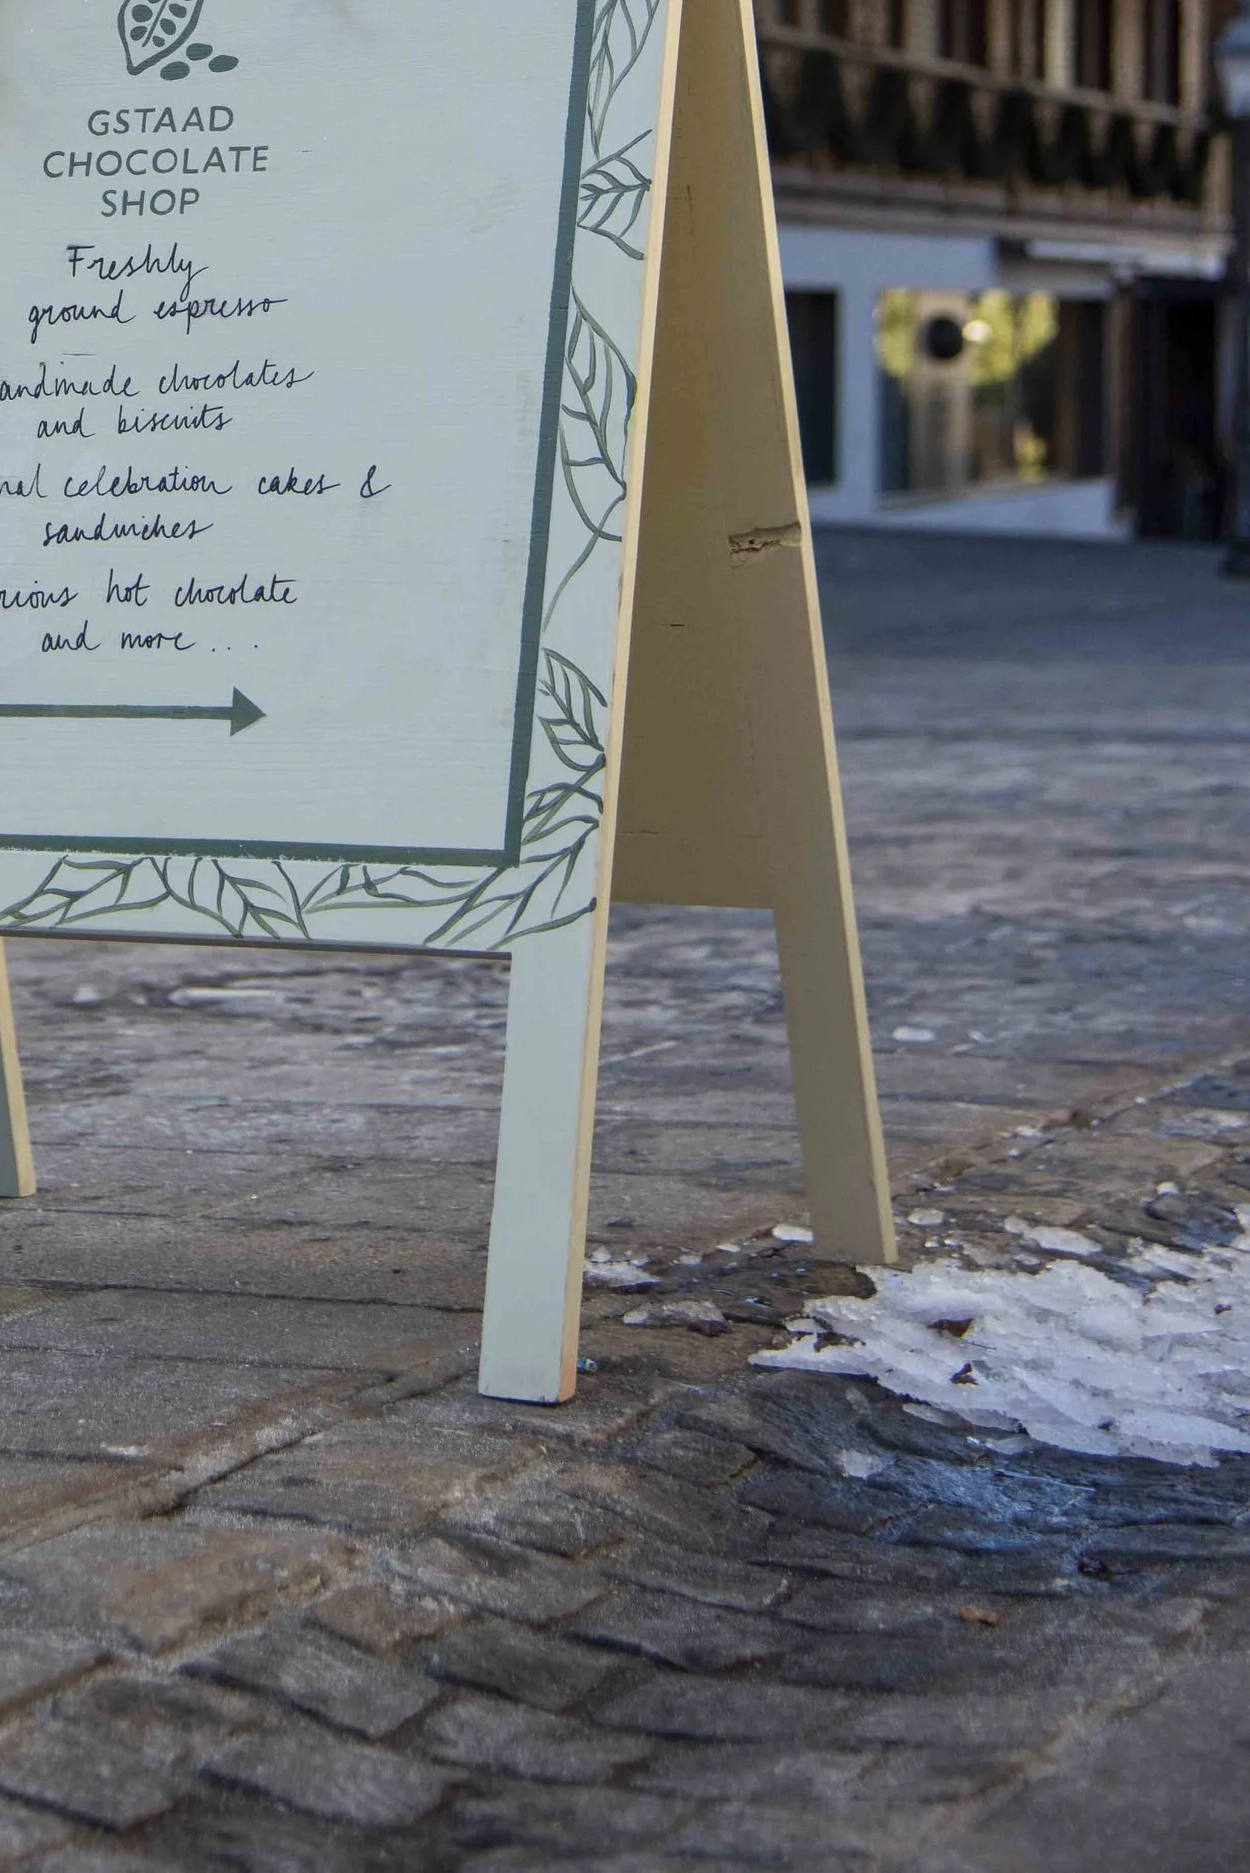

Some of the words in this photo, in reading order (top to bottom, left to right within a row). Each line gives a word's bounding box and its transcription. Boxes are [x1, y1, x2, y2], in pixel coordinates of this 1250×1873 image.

[88, 106, 234, 136] GSTAAD
[43, 146, 268, 178] CHOCOLATE
[101, 189, 199, 217] SHOP
[67, 243, 208, 301] Freshly
[28, 289, 136, 344] ground
[153, 298, 287, 334] espresso
[158, 363, 314, 395] chocolates
[37, 409, 94, 439] and
[118, 405, 232, 434] biscuits
[64, 466, 232, 498] celebration
[258, 468, 340, 496] cakes
[360, 466, 391, 498] &
[43, 515, 213, 547] sandwiches
[106, 569, 147, 606] hot
[174, 575, 297, 606] chocolate
[42, 621, 101, 653] and
